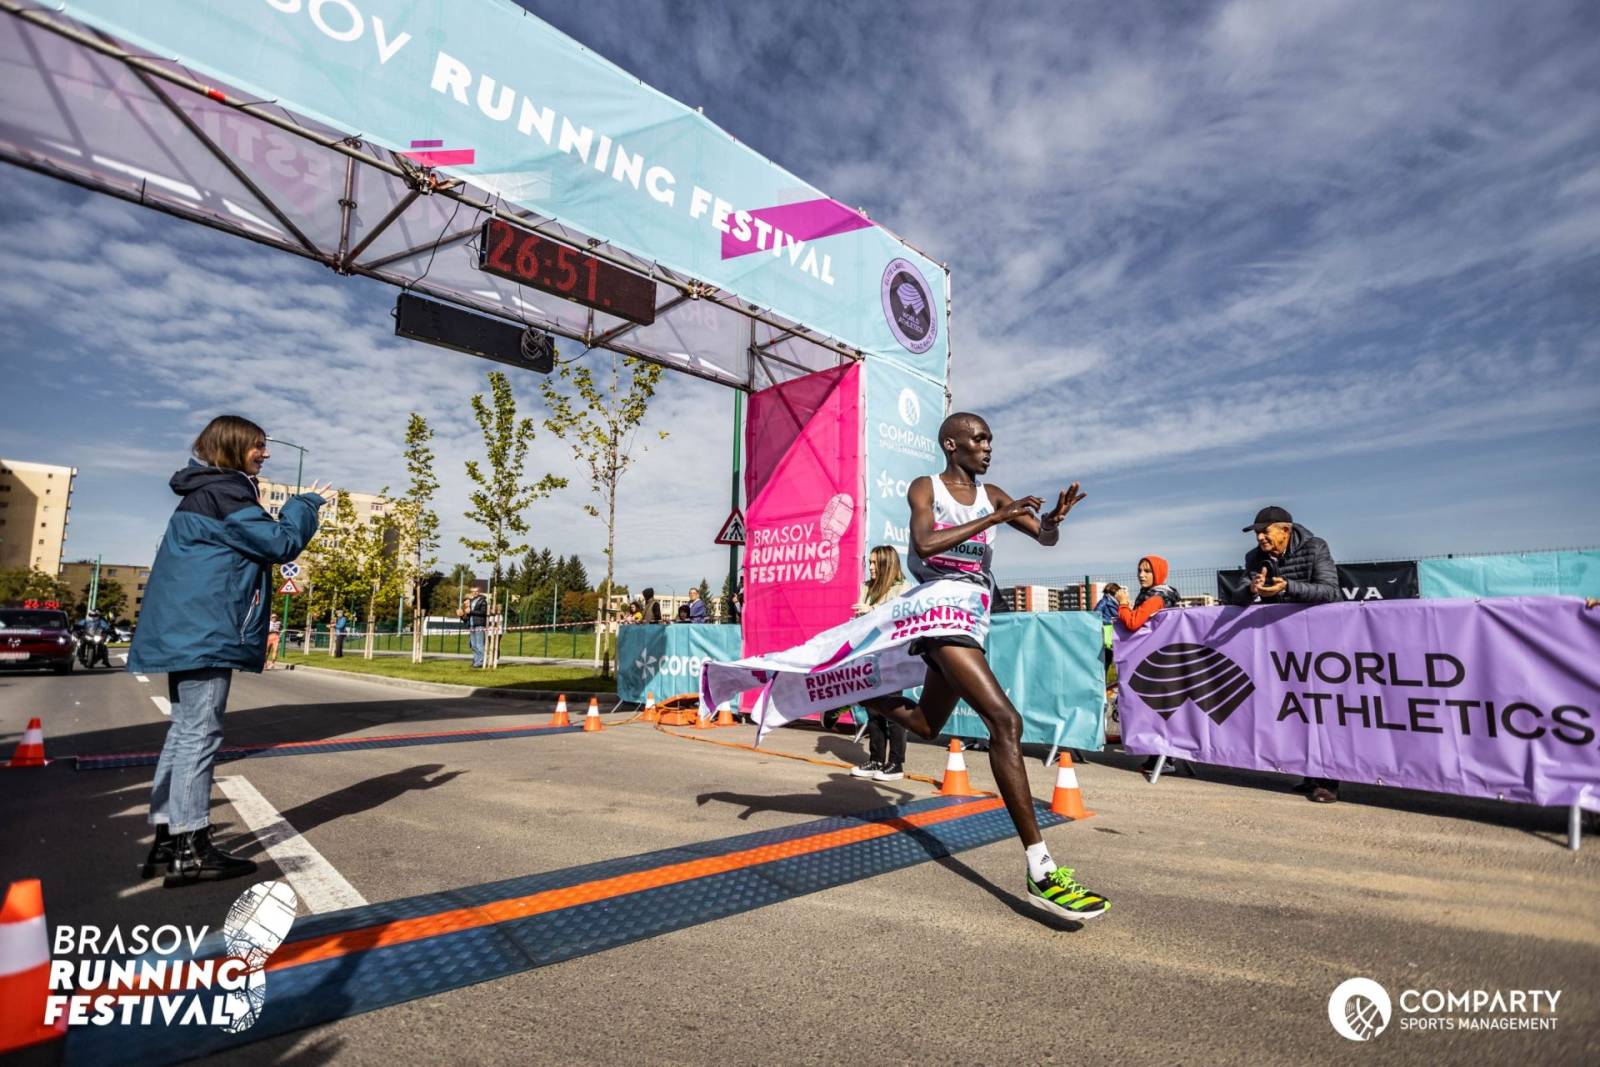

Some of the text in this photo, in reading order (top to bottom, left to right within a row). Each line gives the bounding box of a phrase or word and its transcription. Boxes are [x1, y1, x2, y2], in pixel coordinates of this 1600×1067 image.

[430, 51, 676, 207] RUNNING
[690, 186, 835, 286] FESTIVAL
[879, 422, 936, 453] COMPARTY
[753, 522, 815, 546] BRASOV
[750, 540, 832, 565] RUNNING
[750, 561, 825, 584] FESTIVAL
[805, 663, 873, 690] RUNNING
[1271, 651, 1465, 688] WORLD
[808, 678, 873, 702] FESTIVAL
[1277, 691, 1595, 746] ATHLETICS
